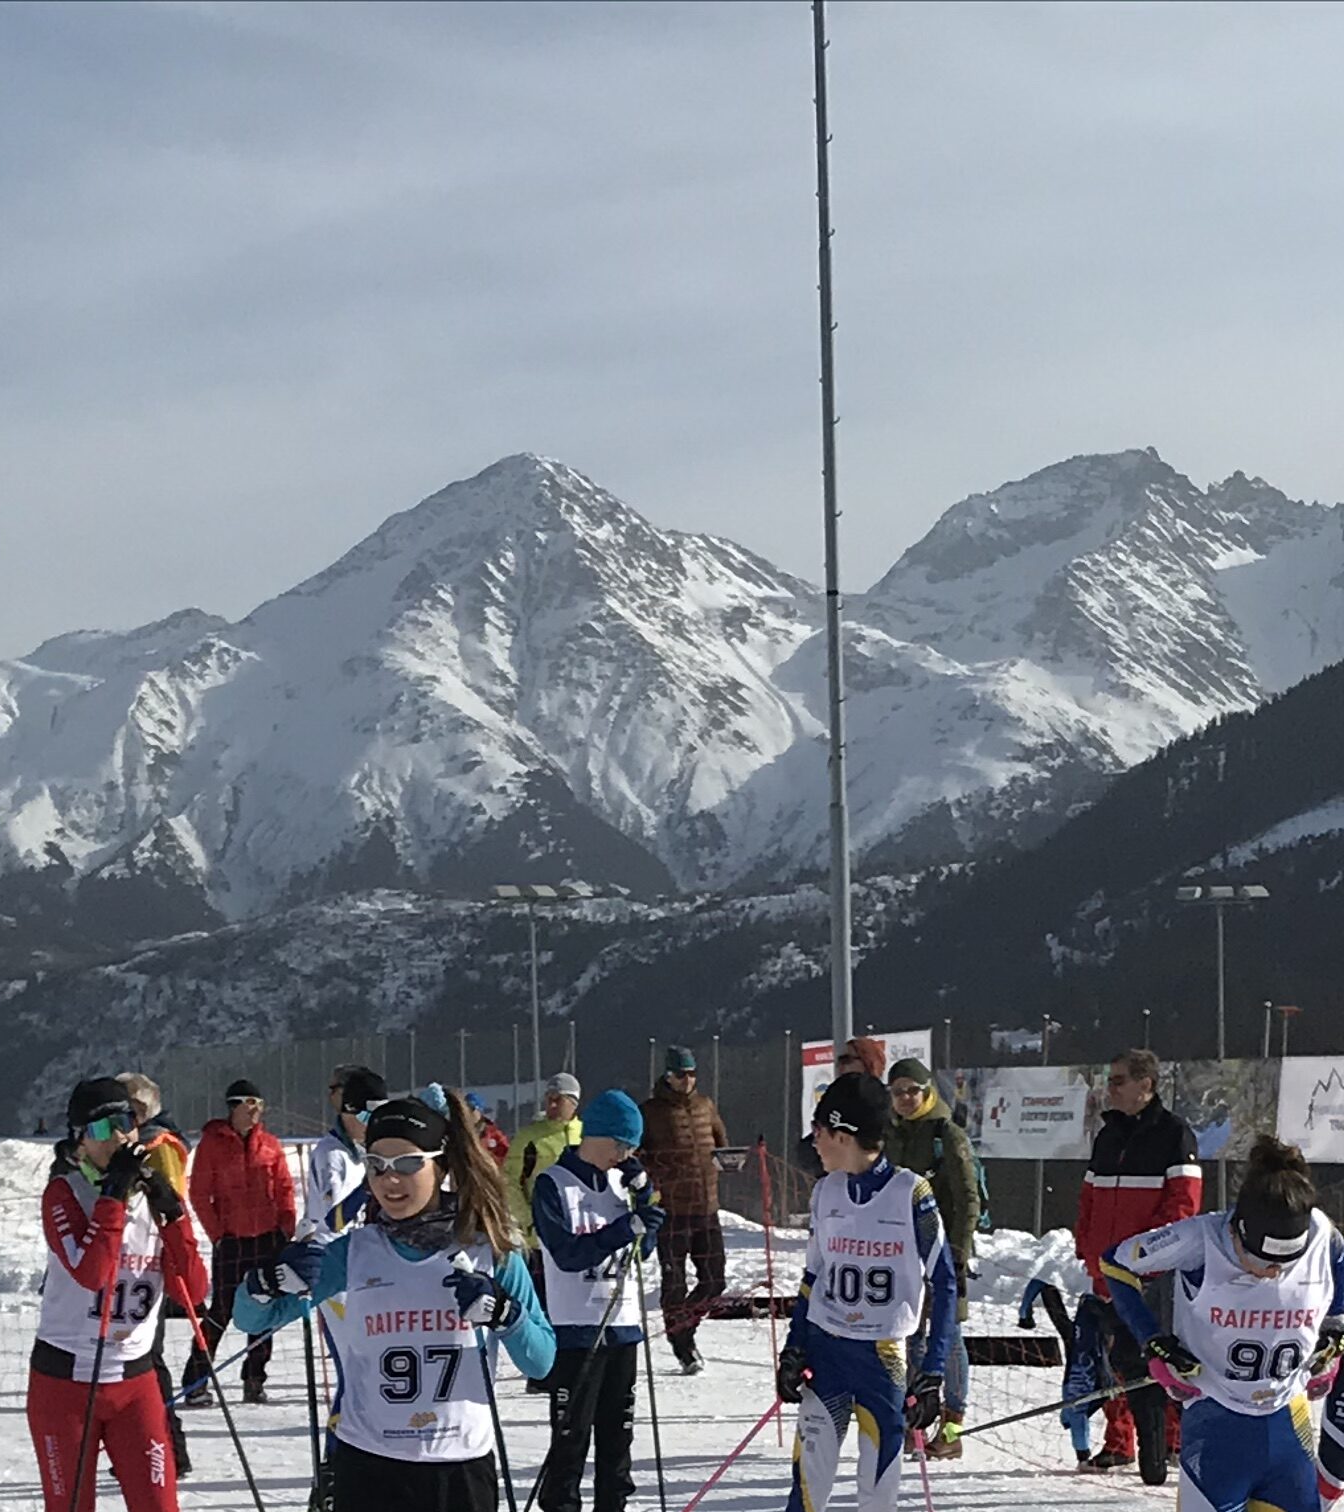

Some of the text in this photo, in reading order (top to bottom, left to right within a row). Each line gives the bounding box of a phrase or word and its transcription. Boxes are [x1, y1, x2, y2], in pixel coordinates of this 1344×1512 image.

[824, 1263, 896, 1306] 109
[364, 1309, 469, 1337] RAIFFEISE
[1209, 1307, 1317, 1329] RAIFFEISE
[379, 1344, 463, 1404] 97
[1226, 1339, 1304, 1381] 90
